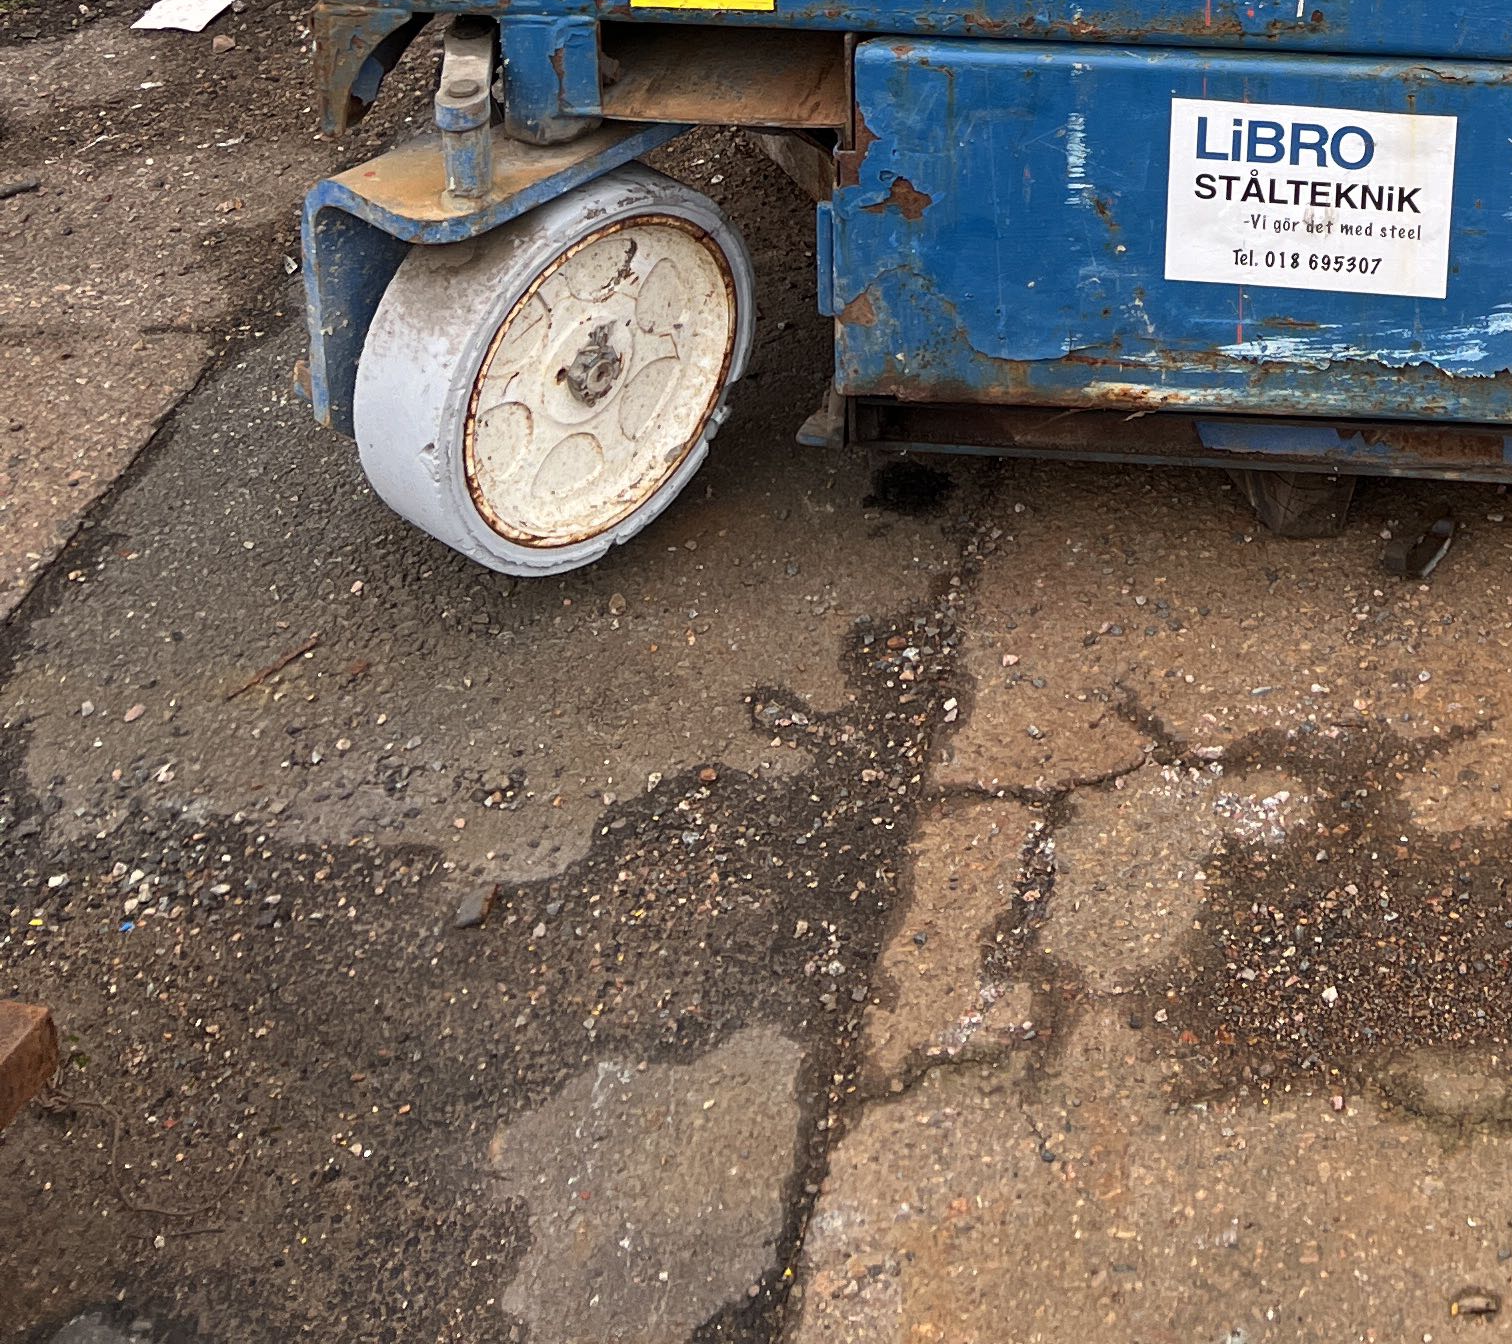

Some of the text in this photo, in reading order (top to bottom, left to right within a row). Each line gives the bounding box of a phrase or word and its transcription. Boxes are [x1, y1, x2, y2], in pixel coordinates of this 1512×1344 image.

[1273, 216, 1300, 235] gör
[1305, 216, 1335, 236] det
[1340, 221, 1373, 238] med
[1379, 224, 1422, 242] steel
[1232, 248, 1383, 276] Tel. 018 695307
